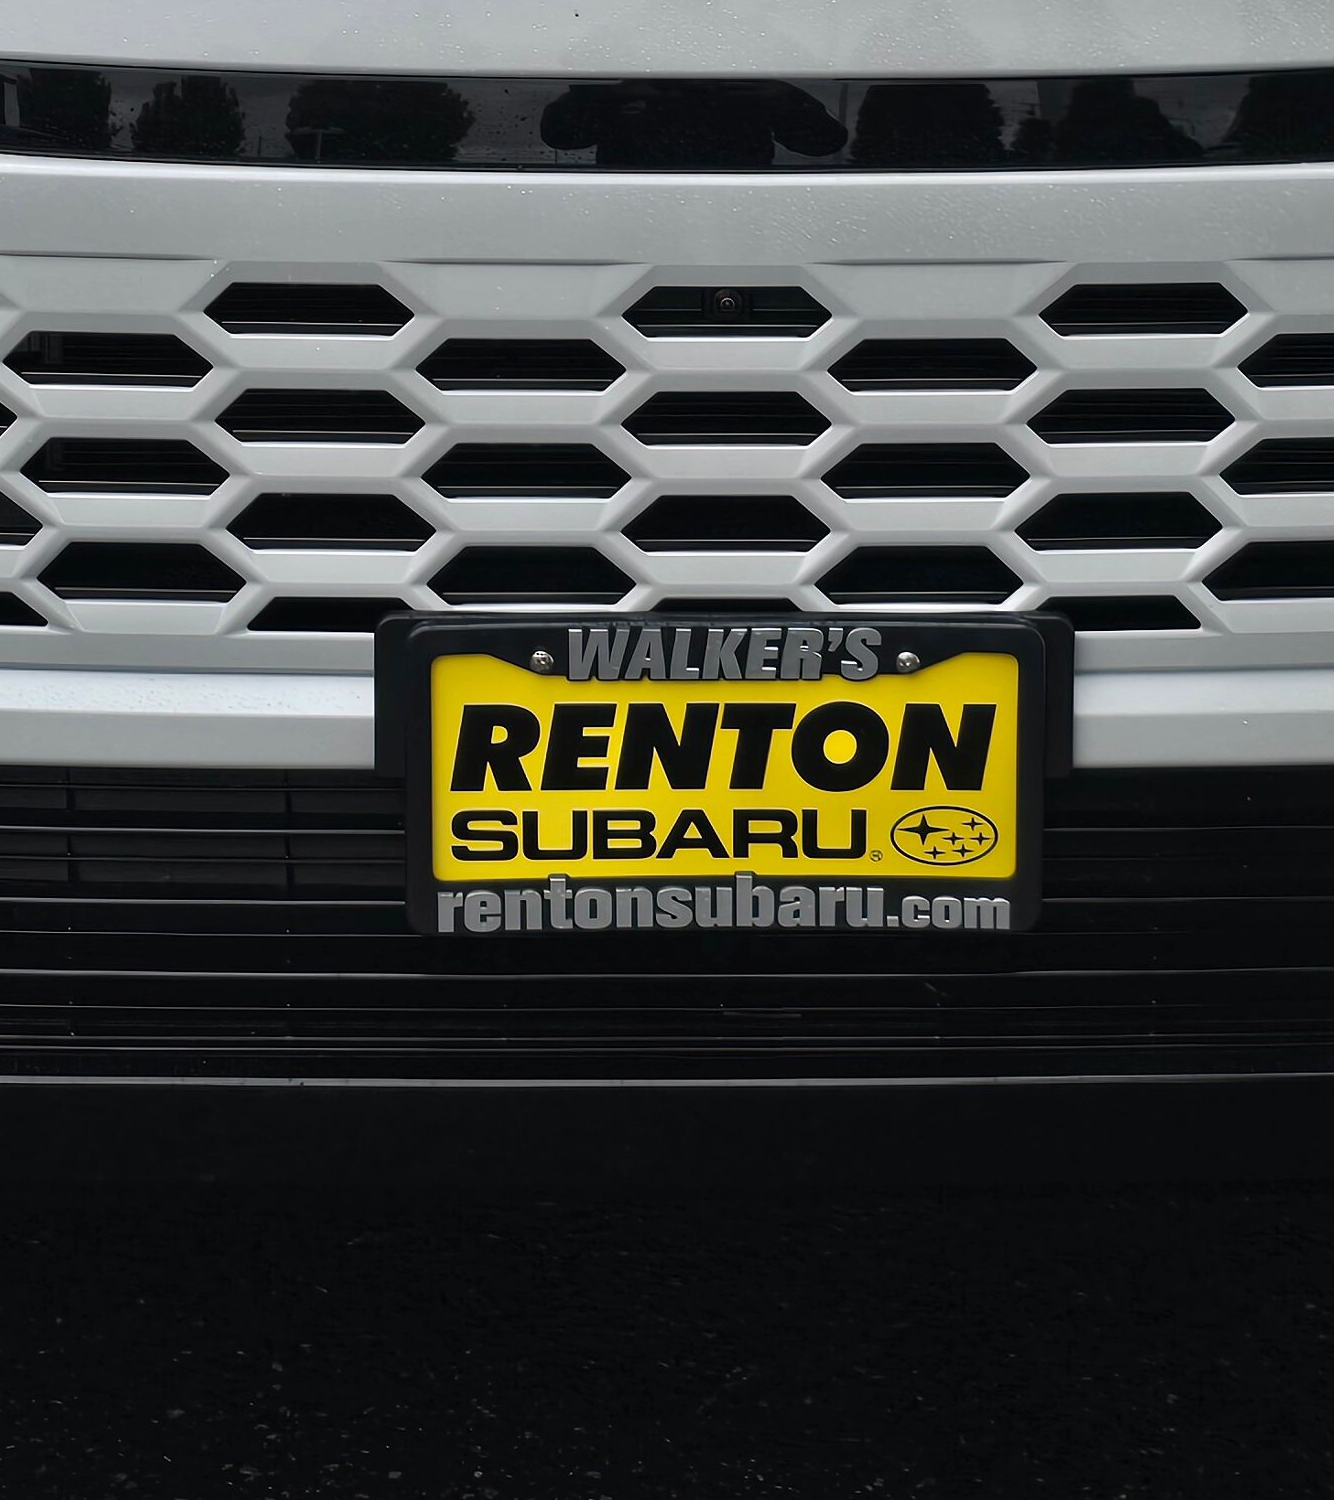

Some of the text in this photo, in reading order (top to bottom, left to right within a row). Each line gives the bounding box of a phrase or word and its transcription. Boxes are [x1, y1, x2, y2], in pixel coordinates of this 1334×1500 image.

[567, 627, 882, 681] WALKER'S
[449, 702, 998, 793] RENTON
[451, 809, 868, 861] SUBARU
[437, 873, 1011, 933] rentonsubaru.com
